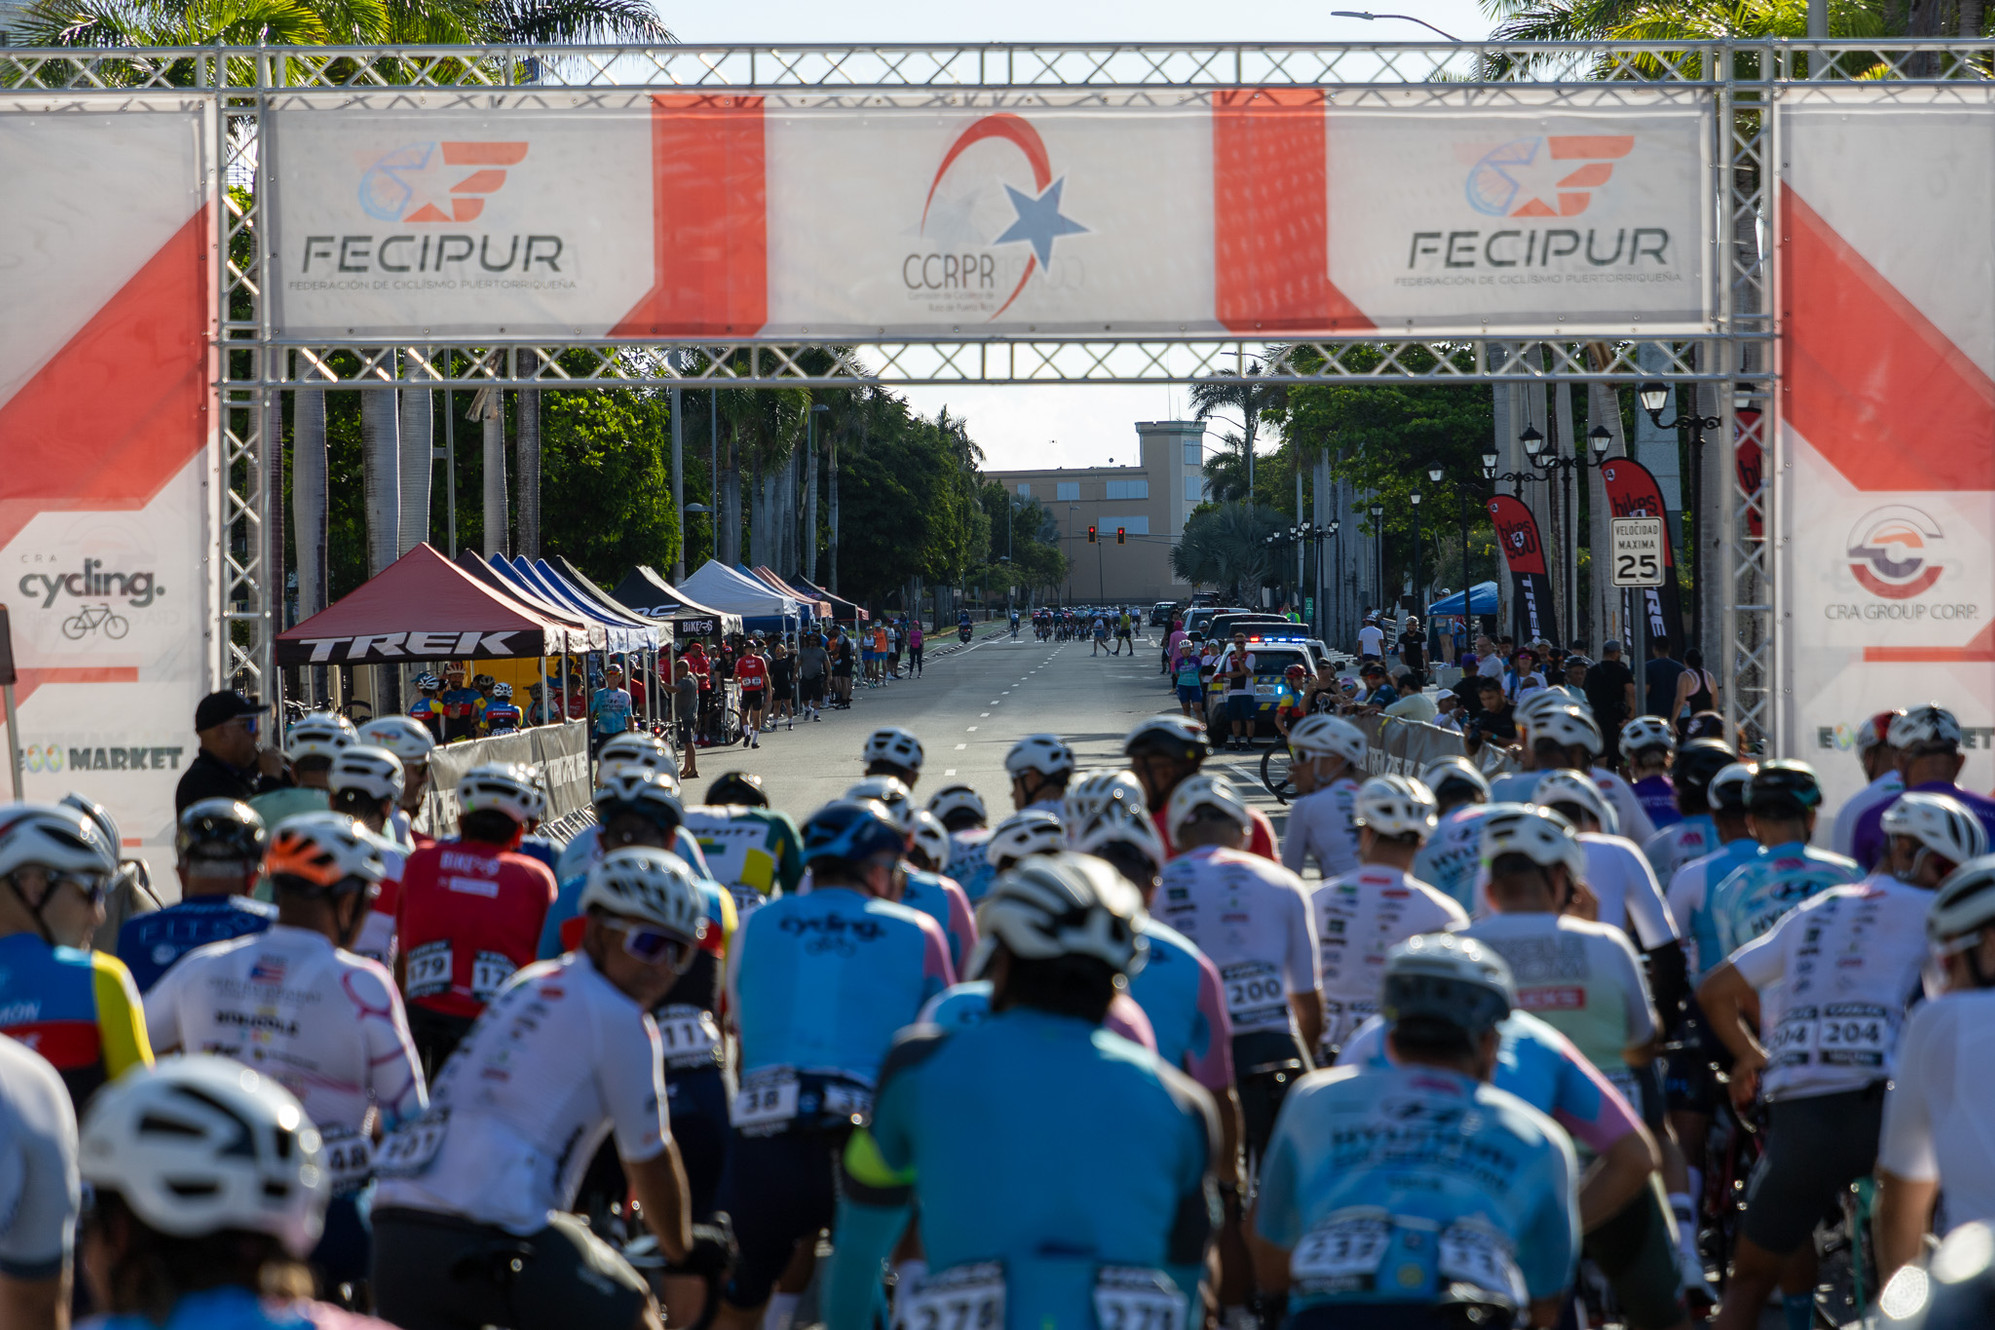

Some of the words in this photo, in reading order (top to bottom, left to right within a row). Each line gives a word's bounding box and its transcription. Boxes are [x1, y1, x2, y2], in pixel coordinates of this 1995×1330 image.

[302, 234, 564, 274] FECIPUR
[1408, 228, 1670, 269] FECIPUR
[903, 253, 995, 290] CCRPR
[1479, 275, 1494, 285] DE
[373, 280, 390, 290] DE
[1615, 525, 1658, 536] VELOCIDAD
[1618, 540, 1655, 550] MAXIMA
[1617, 554, 1658, 579] 25
[1825, 604, 1861, 620] CRA
[1864, 604, 1927, 620] GROUP
[1930, 603, 1979, 620] CORP.
[300, 631, 521, 662] TREK
[69, 746, 183, 771] MARKET
[1230, 978, 1281, 1005] 200
[1825, 1022, 1880, 1043] 204
